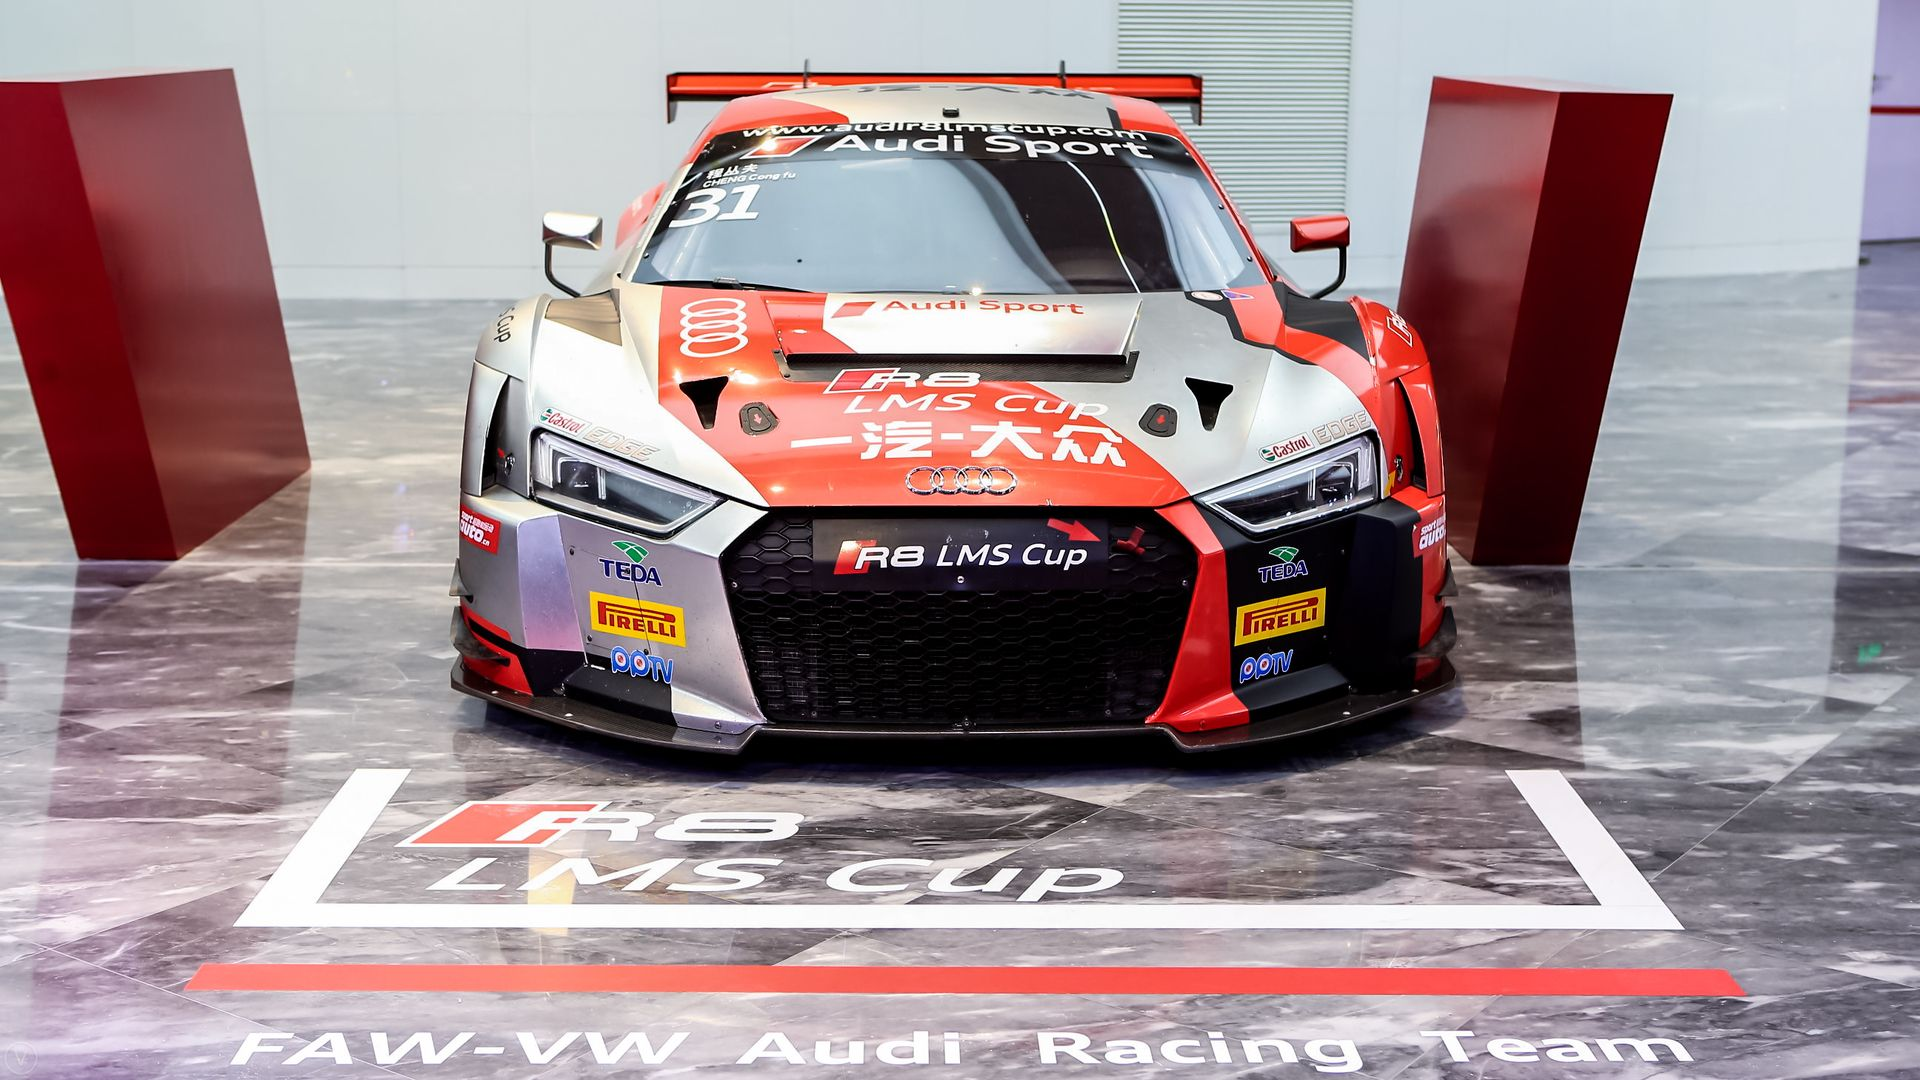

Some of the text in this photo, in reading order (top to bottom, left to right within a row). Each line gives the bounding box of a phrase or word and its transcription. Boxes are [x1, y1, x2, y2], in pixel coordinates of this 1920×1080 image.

[823, 134, 1154, 159] Audi Sport
[702, 171, 796, 188] CHENG Cong fu
[669, 184, 761, 228] 31
[882, 300, 1085, 315] Audi Sport
[860, 371, 981, 389] R8
[844, 393, 1109, 420] LMS Cup
[548, 412, 661, 462] Castrol EDGE
[1272, 410, 1372, 458] Castrol EDGE
[854, 543, 1087, 570] R8 LMS Cup
[1258, 560, 1308, 583] TEDA
[598, 557, 663, 588] TEDA
[597, 600, 677, 638] PIRELLI
[1243, 596, 1319, 637] PIRELLI
[495, 811, 805, 841] R8
[425, 857, 1125, 902] LMS Cup
[229, 1030, 1696, 1074] FAW-VW Audi Racing Team
